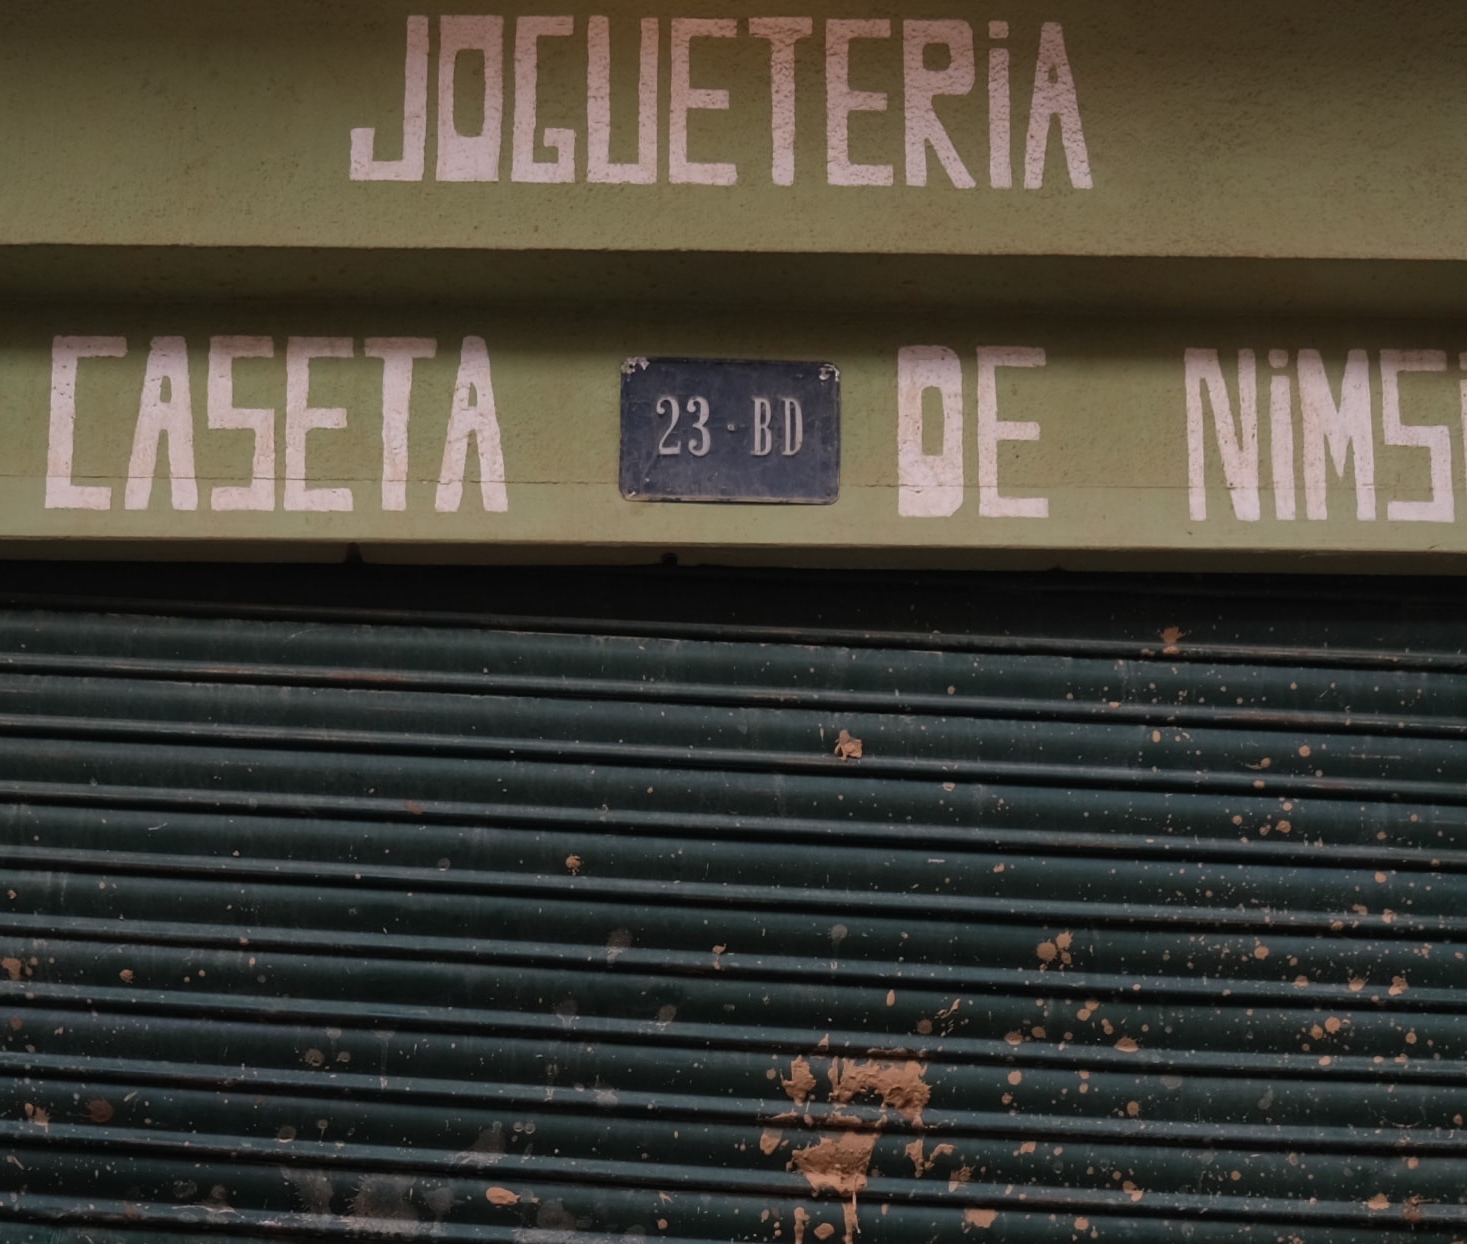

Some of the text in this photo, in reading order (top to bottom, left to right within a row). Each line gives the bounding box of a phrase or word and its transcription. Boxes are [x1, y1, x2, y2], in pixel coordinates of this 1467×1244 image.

[43, 335, 510, 513] CASETA
[897, 345, 1050, 519] DE
[655, 395, 804, 457] 23 BD
